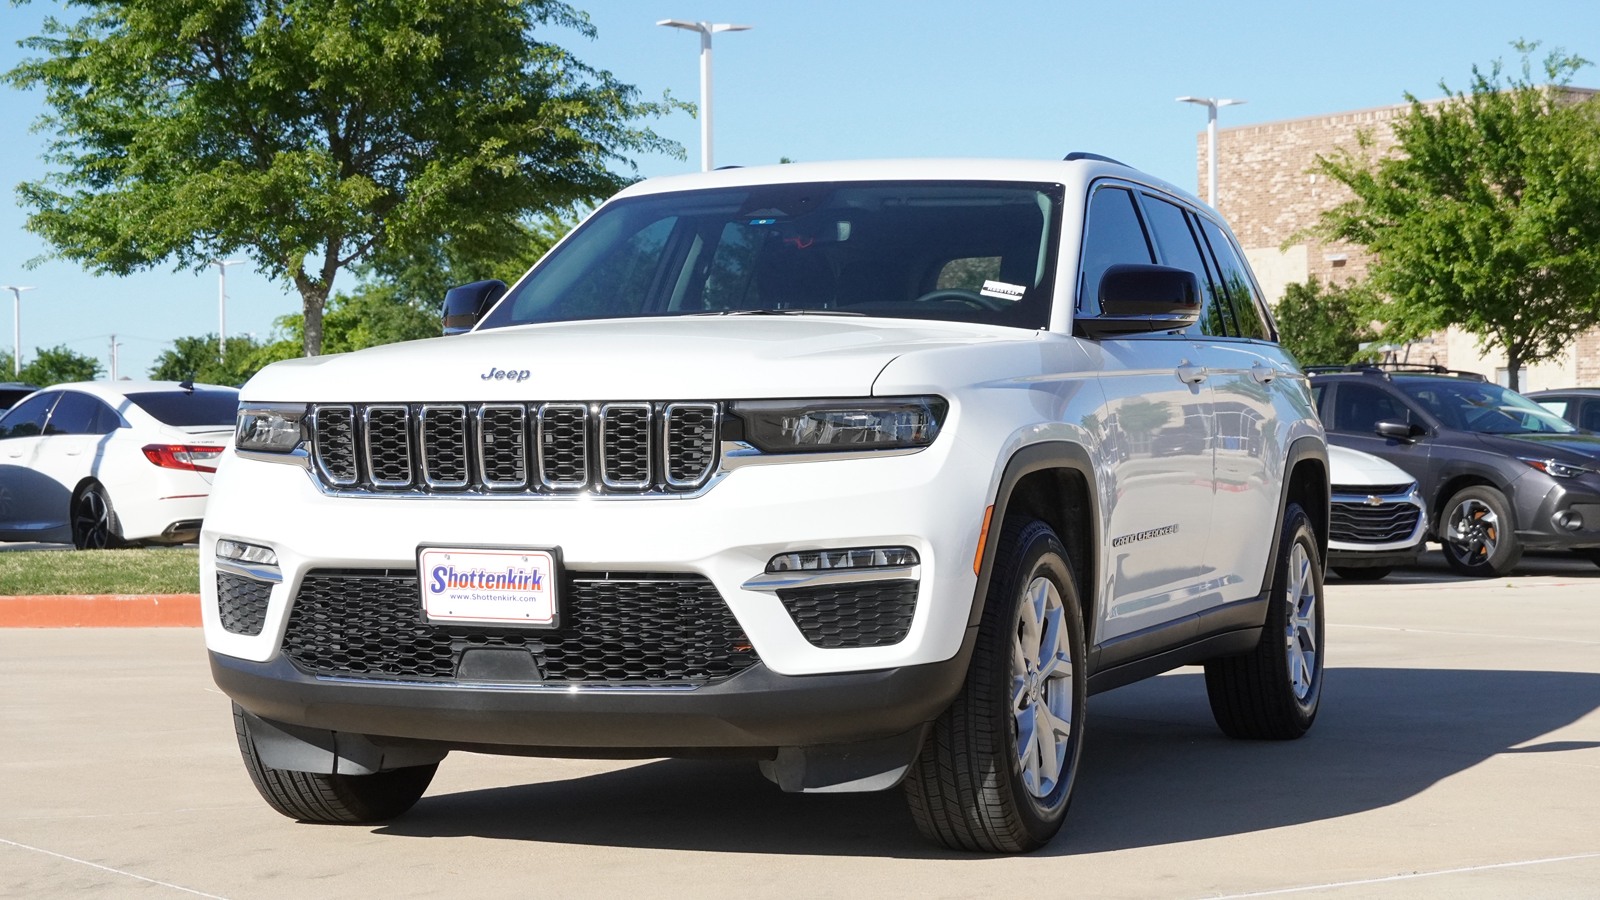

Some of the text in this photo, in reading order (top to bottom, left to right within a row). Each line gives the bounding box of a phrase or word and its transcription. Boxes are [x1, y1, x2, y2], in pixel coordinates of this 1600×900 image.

[481, 367, 531, 383] Jeep
[430, 565, 543, 594] Shottenkirk
[449, 593, 537, 602] www.Shottenkirk.com
